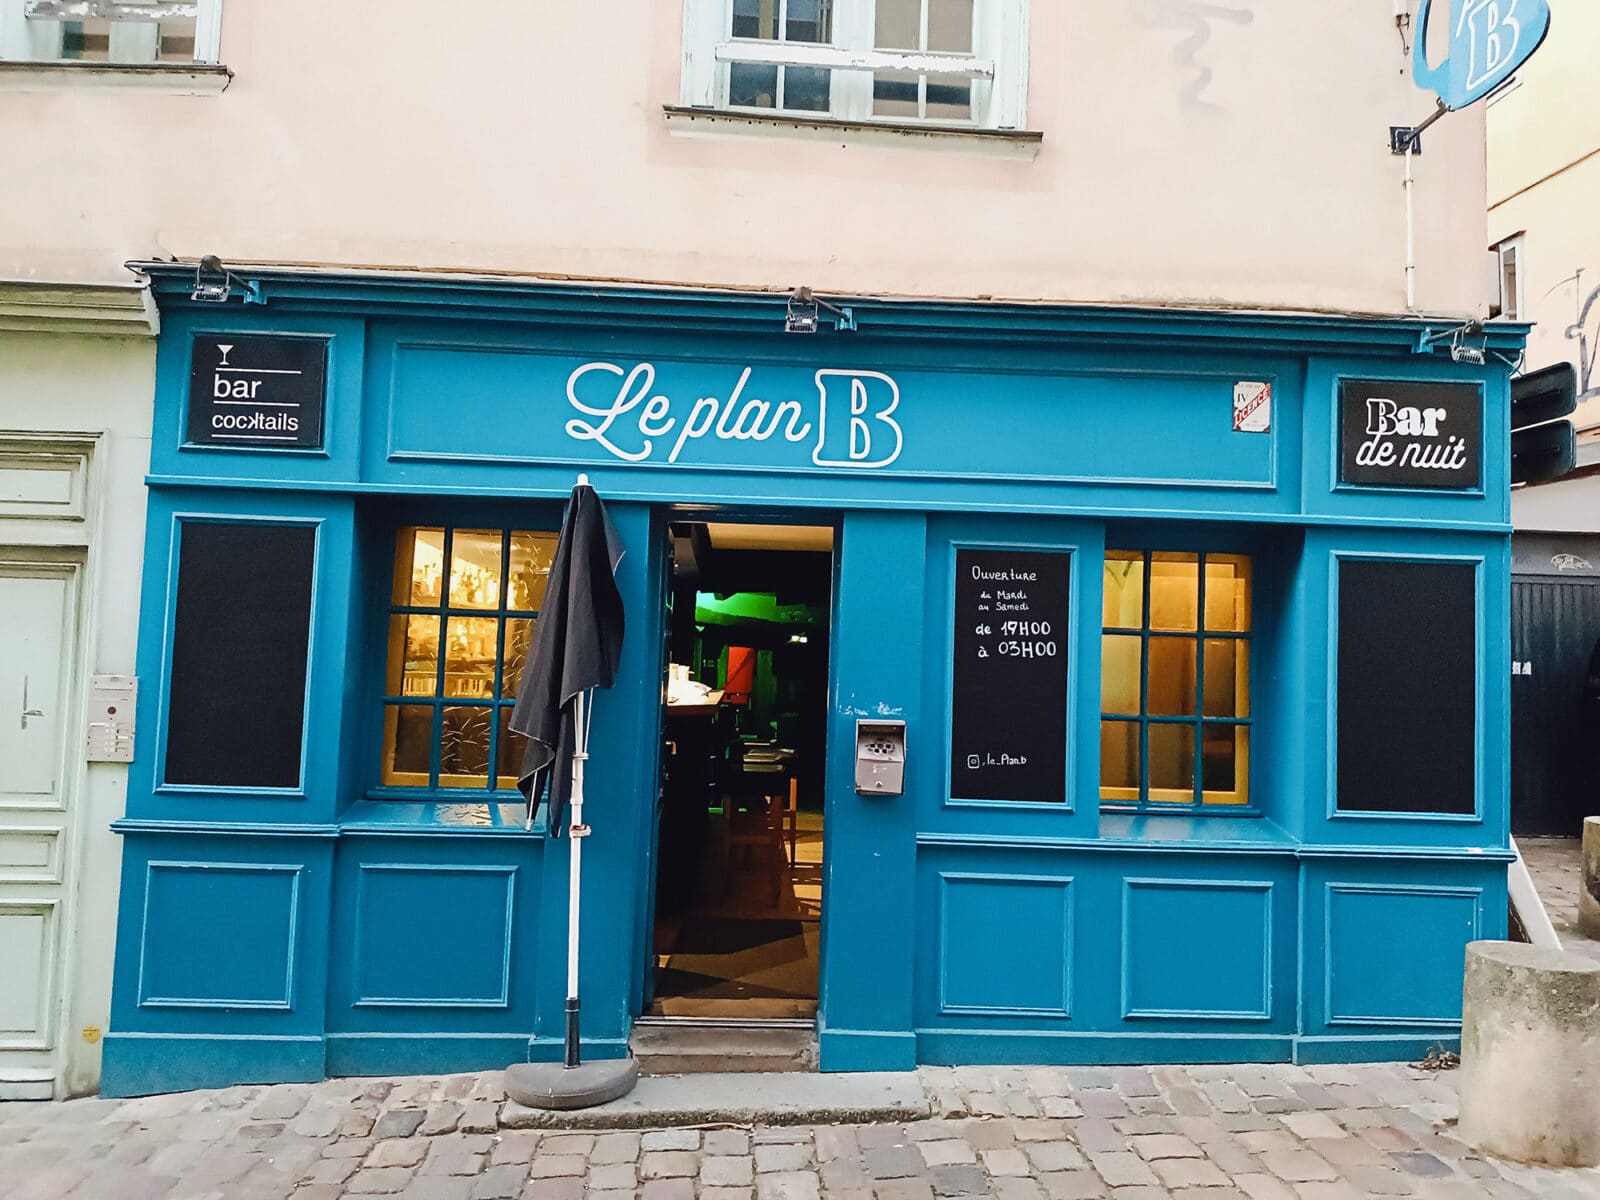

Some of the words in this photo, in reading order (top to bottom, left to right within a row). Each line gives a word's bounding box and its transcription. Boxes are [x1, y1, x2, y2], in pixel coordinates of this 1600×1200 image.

[213, 373, 262, 399] bar
[565, 362, 676, 461] Le
[668, 367, 811, 463] plan
[812, 368, 903, 468] B
[1232, 388, 1270, 427] LICENCE
[1365, 398, 1447, 436] Bar
[212, 412, 299, 431] cocktails
[1355, 430, 1398, 467] de
[1399, 435, 1467, 470] nuit
[995, 601, 1030, 611] Samedi
[975, 623, 992, 635] de
[977, 646, 990, 658] à
[998, 641, 1057, 658] 03H00
